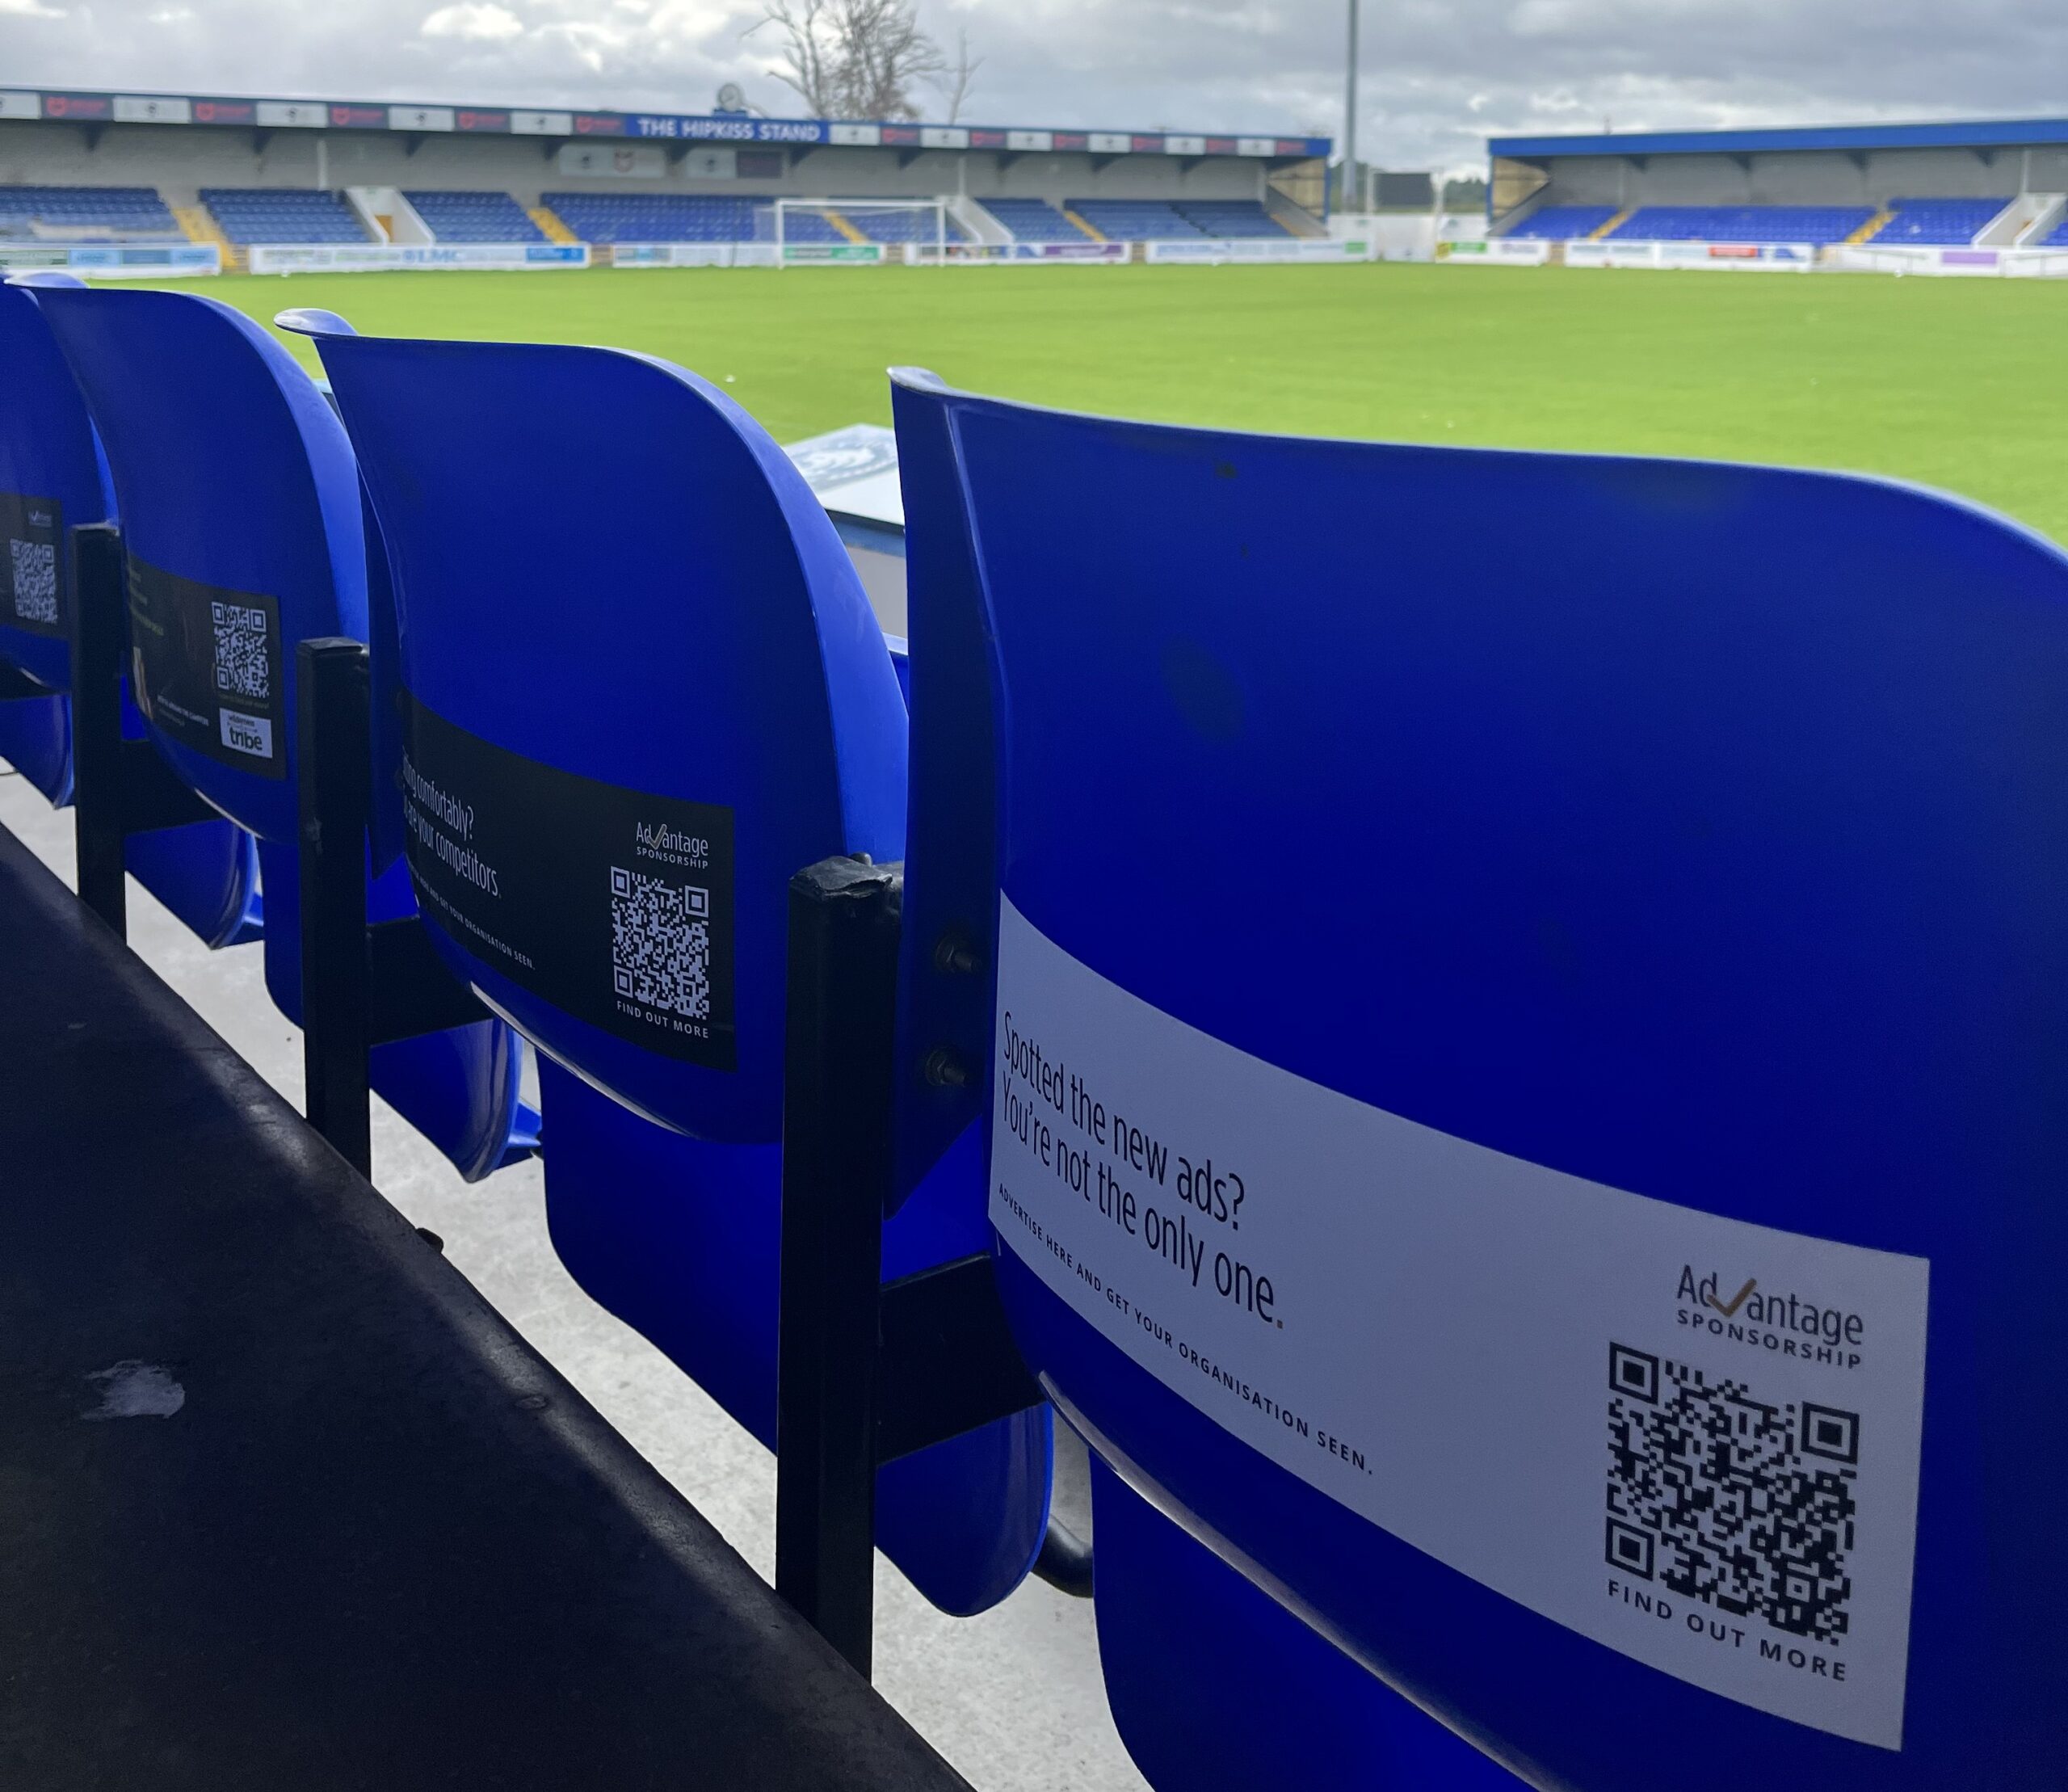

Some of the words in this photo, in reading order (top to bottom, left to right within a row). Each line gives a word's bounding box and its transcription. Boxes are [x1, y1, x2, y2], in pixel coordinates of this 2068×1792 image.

[638, 118, 677, 137] THE
[682, 120, 754, 140] HIPKISS
[759, 124, 821, 142] STAND
[229, 726, 263, 750] tribe
[417, 774, 475, 841] comfortably?
[418, 812, 435, 849] your
[435, 831, 502, 899] competitors.
[637, 846, 708, 869] SPONSORSHIP
[464, 918, 512, 957] ORGANISATION
[514, 950, 536, 970] SEEN.
[616, 1000, 641, 1018] FIND
[645, 1011, 669, 1028] OUT
[674, 1020, 708, 1039] MORE
[1004, 1011, 1064, 1115] Spotted
[1070, 1074, 1106, 1146] the
[1113, 1114, 1168, 1187] new
[1176, 1156, 1245, 1231] ads?
[1002, 1071, 1051, 1167] You're
[1057, 1138, 1091, 1202] not
[1097, 1161, 1137, 1235] the
[1145, 1207, 1204, 1288] only
[1214, 1251, 1284, 1330] one.
[998, 1183, 1043, 1242] ADVERTISE
[1046, 1234, 1073, 1268] HERE
[1076, 1262, 1101, 1292] AND
[1106, 1287, 1129, 1315] GET
[1134, 1307, 1173, 1349] YOUR
[1179, 1342, 1309, 1438] ORGANISATION
[1317, 1430, 1372, 1475] SEEN.
[1677, 1309, 1861, 1369] SPONSORSHIP
[1608, 1578, 1672, 1621] FIND
[1686, 1613, 1746, 1648] OUT
[1759, 1638, 1846, 1682] MORE
